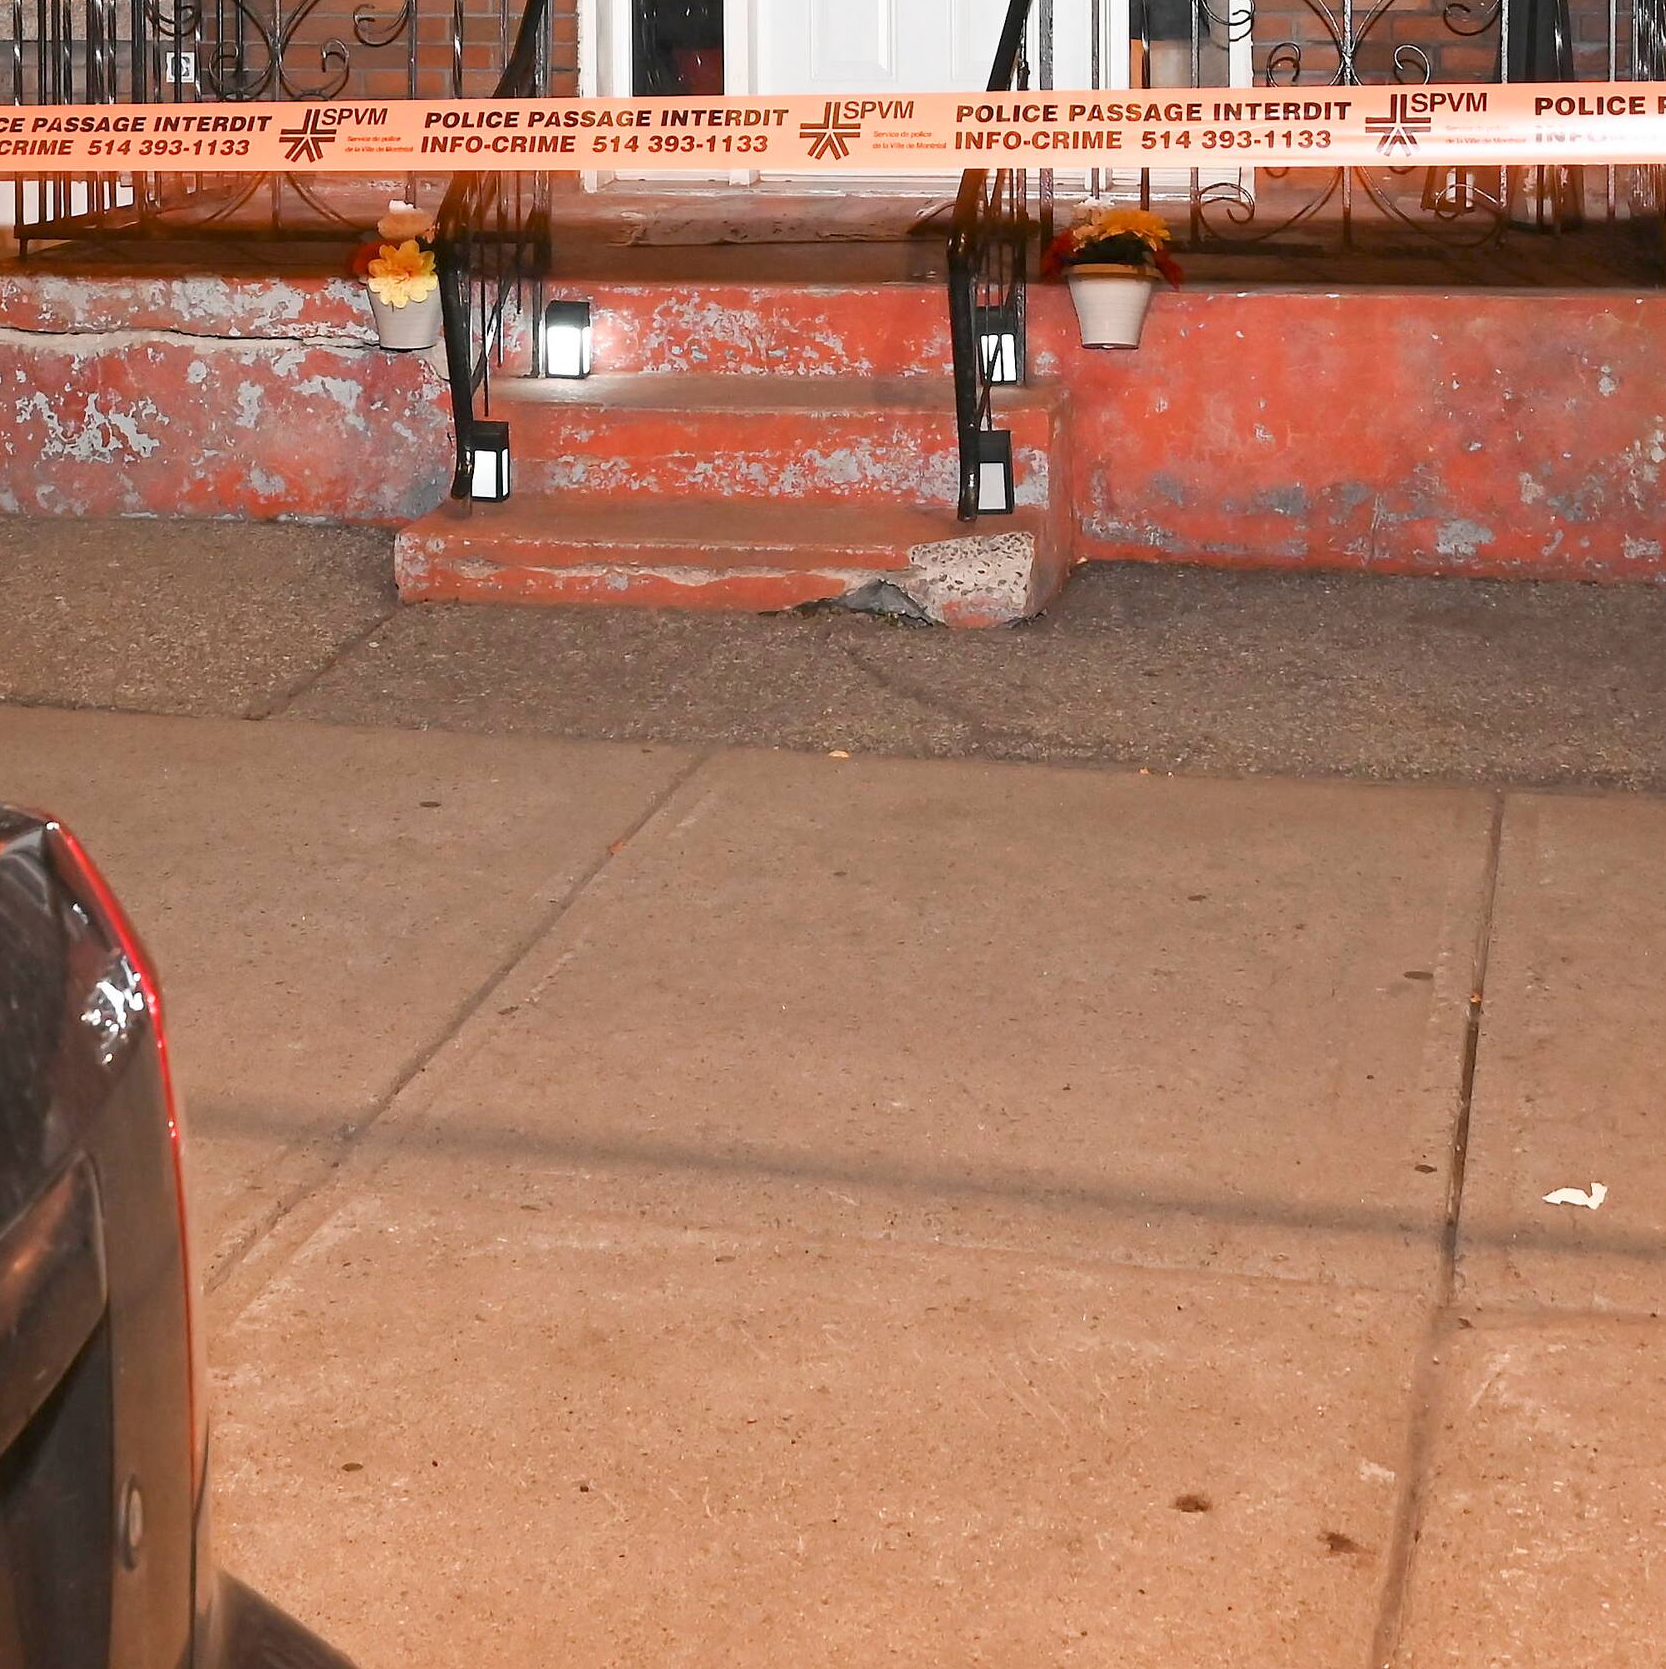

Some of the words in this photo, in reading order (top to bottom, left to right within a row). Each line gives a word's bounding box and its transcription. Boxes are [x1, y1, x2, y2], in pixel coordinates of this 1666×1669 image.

[844, 101, 913, 119] SPVM
[1412, 93, 1487, 112] SPVM
[1535, 96, 1645, 115] POLICE
[322, 108, 387, 125] SPVM
[425, 112, 519, 128] POLICE
[528, 110, 651, 127] PASSAGE
[661, 110, 788, 126] INTERDIT
[957, 105, 1057, 122] POLICE
[1069, 104, 1202, 121] PASSAGE
[1214, 102, 1351, 120] INTERDIT
[32, 117, 146, 132] PASSAGE
[154, 116, 272, 131] INTERDIT
[88, 140, 131, 155] 514
[139, 140, 249, 155] 393-1133
[422, 136, 575, 153] INFO-CRIME
[593, 136, 638, 152] 514
[648, 136, 767, 152] 393-1133
[956, 131, 1121, 149] INFO-CRIME
[1142, 131, 1191, 149] 514
[1202, 130, 1330, 148] 393-1133
